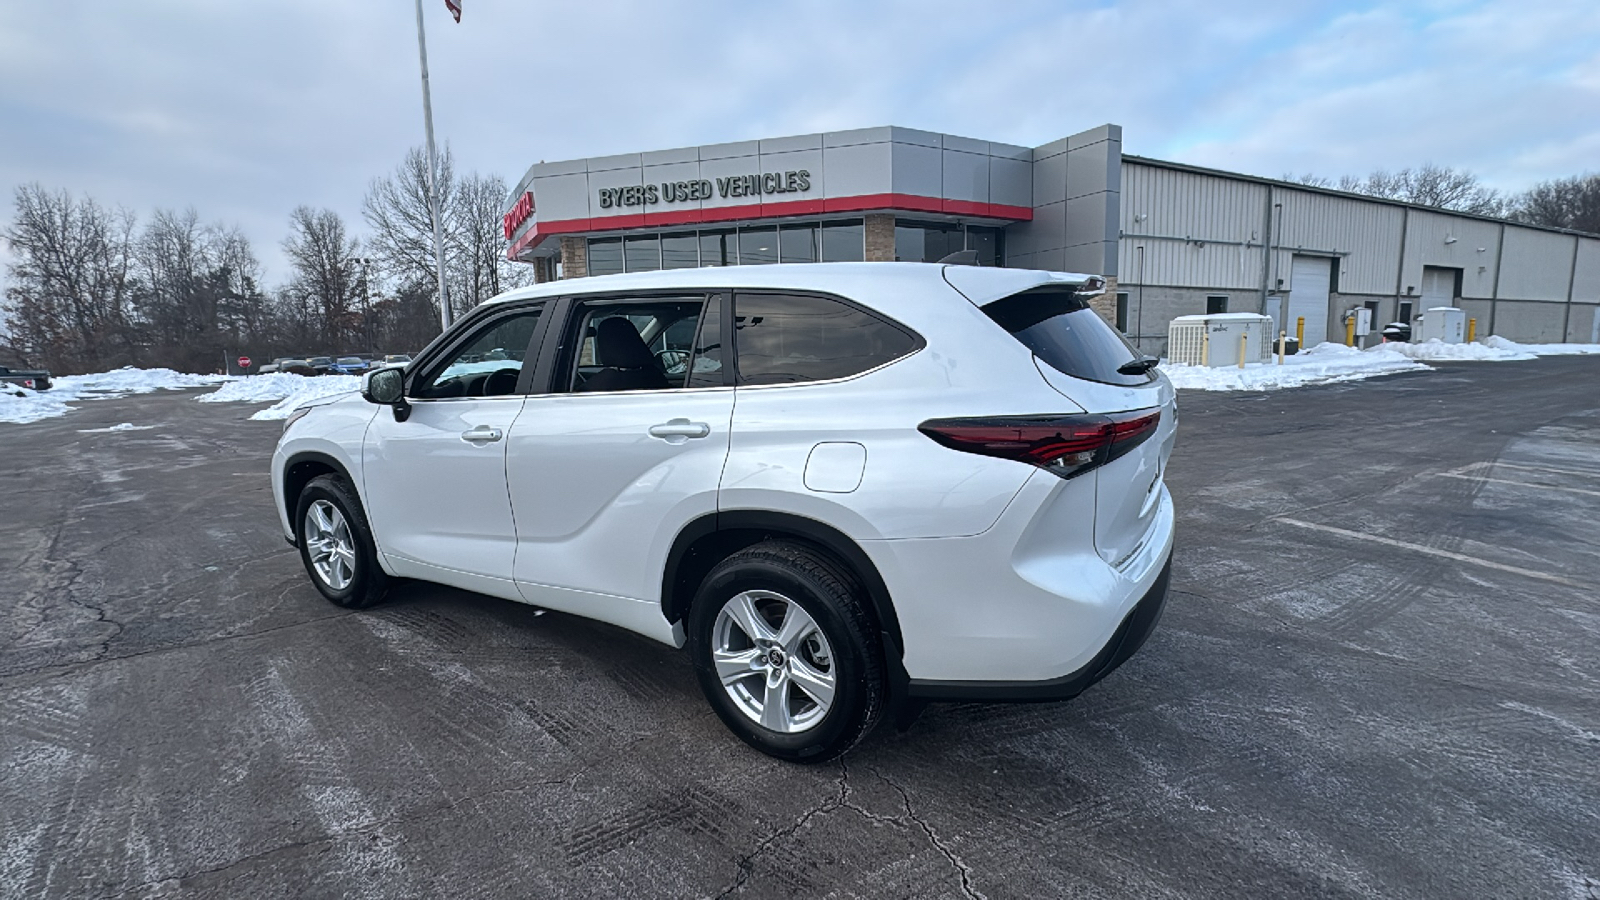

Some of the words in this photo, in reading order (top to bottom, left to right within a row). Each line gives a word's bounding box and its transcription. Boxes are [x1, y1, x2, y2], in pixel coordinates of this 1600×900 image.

[599, 184, 658, 208] BYERS
[662, 179, 712, 203] USED
[716, 170, 810, 198] VEHICLES
